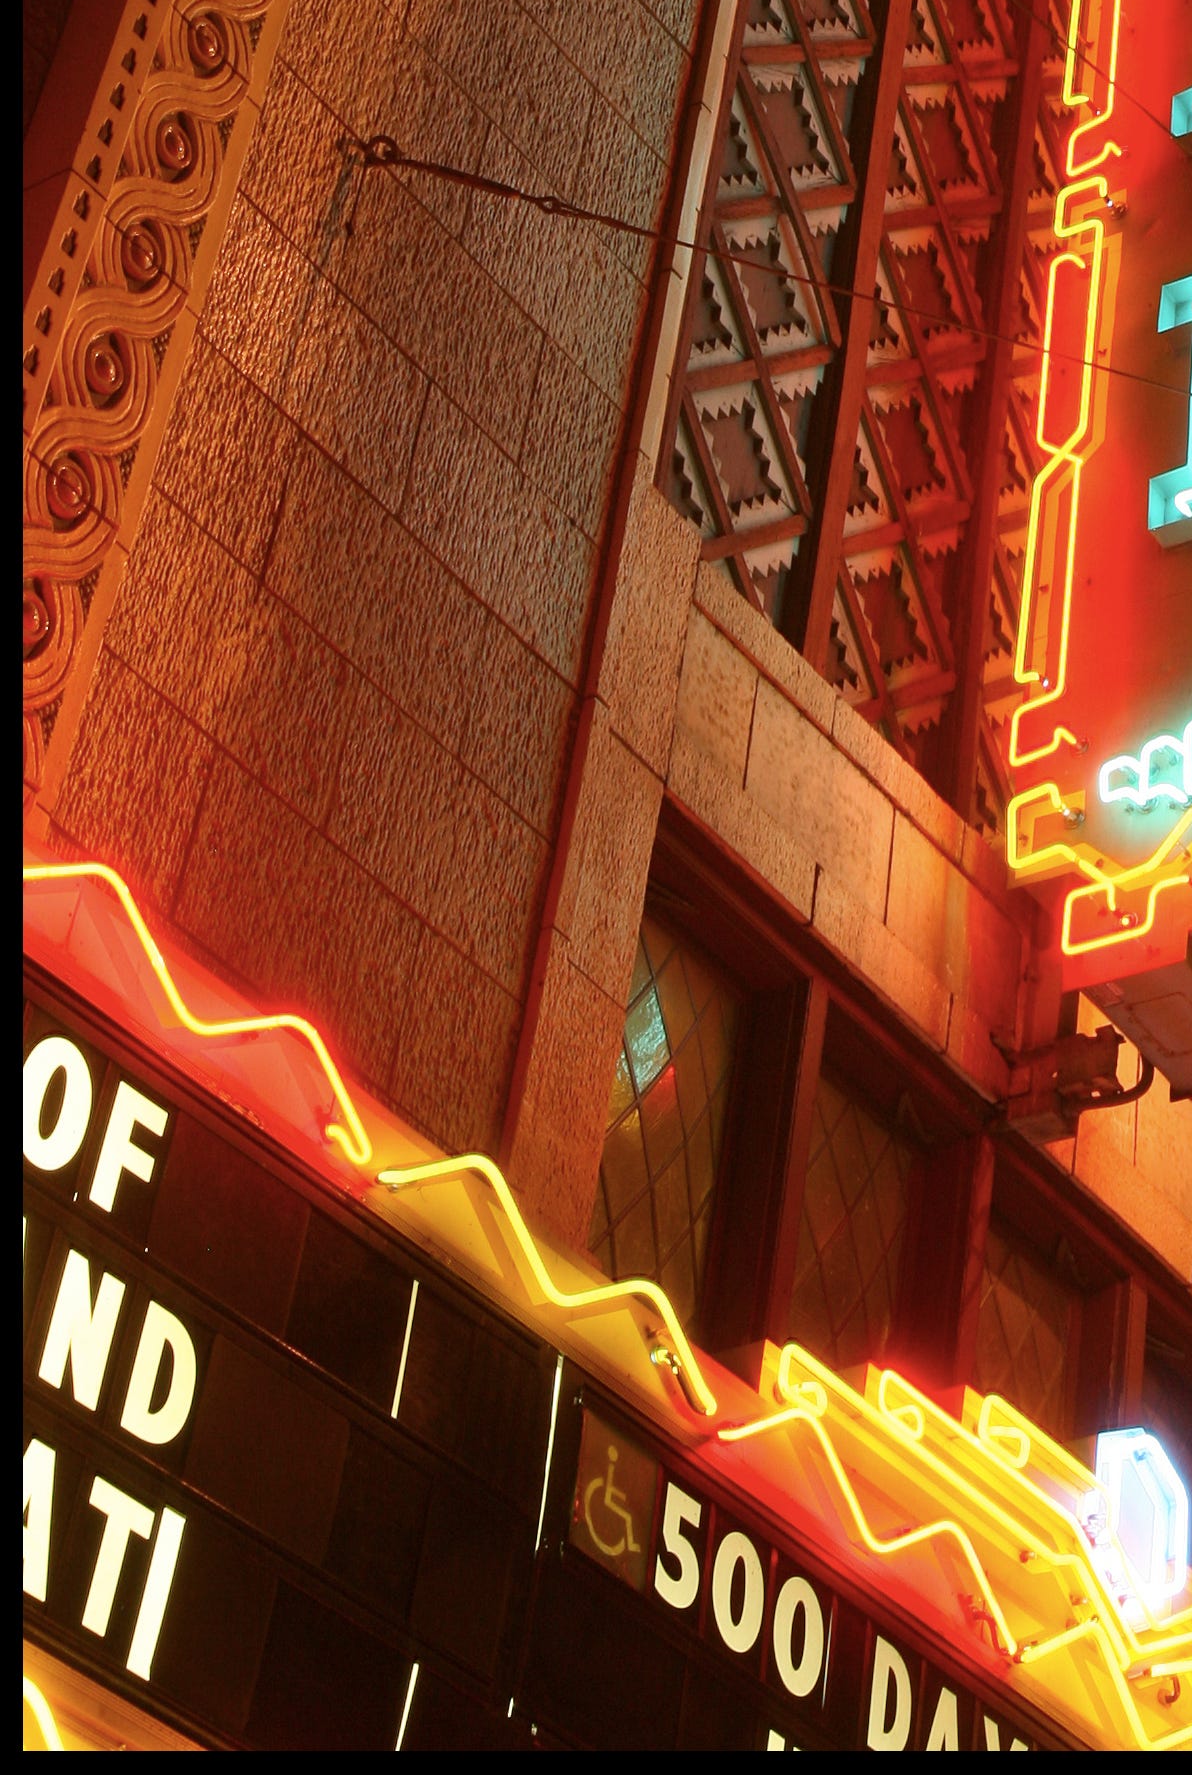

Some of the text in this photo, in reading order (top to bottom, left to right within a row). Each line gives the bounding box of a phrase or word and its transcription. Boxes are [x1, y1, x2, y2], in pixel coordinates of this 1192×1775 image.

[23, 1036, 170, 1213] OF
[23, 1216, 198, 1446] ND
[654, 1481, 824, 1698] 500
